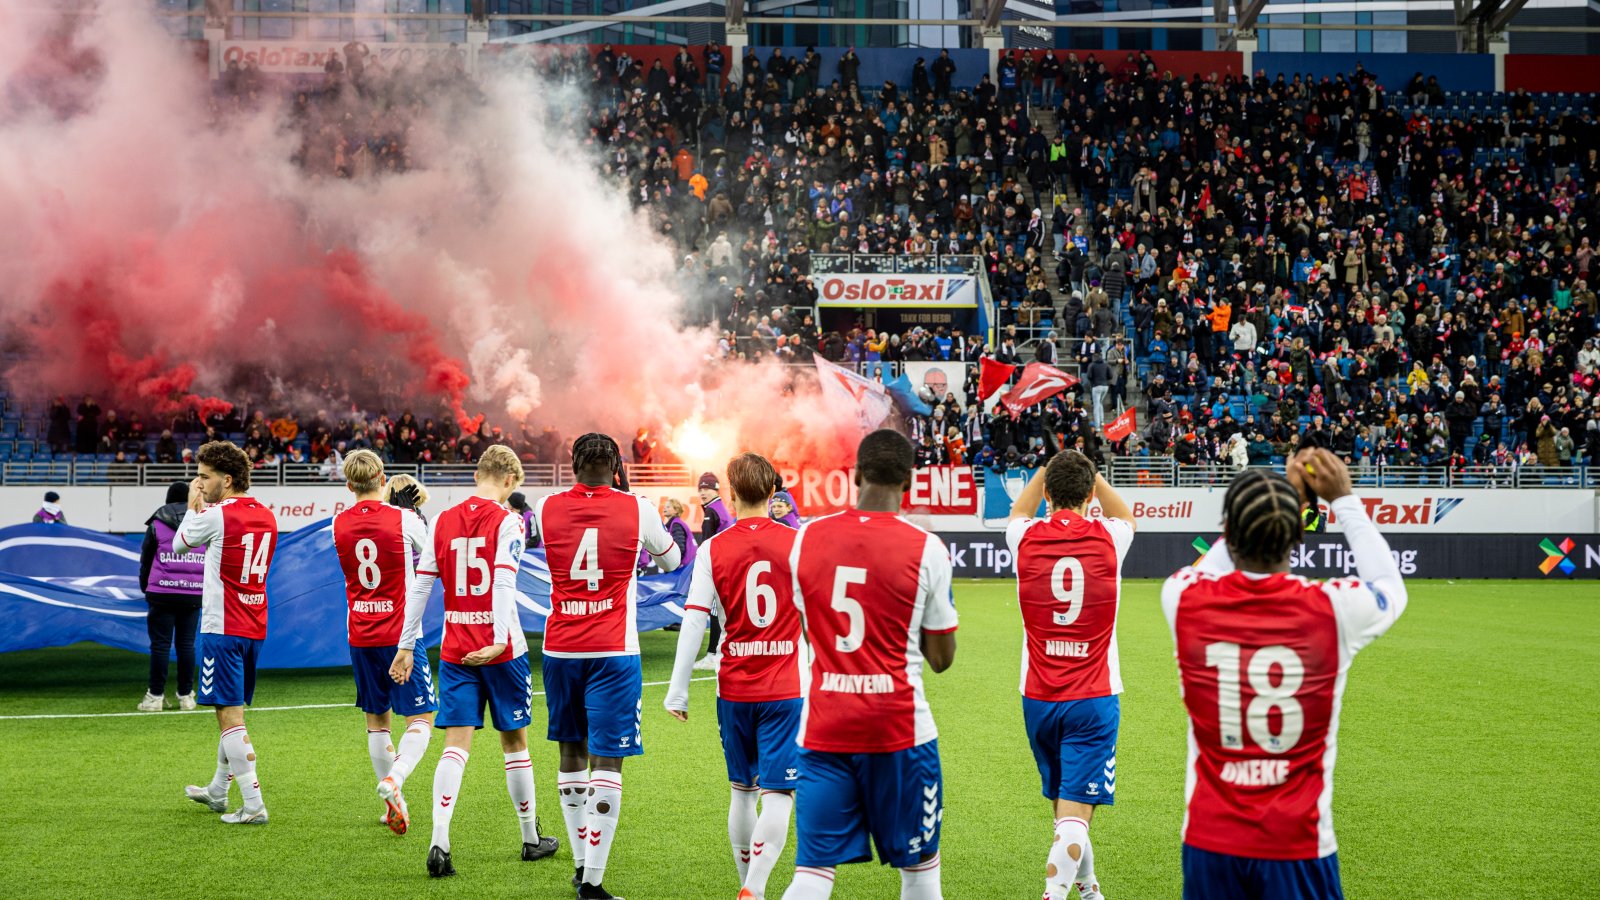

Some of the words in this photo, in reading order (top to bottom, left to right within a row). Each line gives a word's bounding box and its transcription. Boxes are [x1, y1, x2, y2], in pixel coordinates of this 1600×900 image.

[823, 278, 944, 301] OsloTaxi
[280, 503, 313, 517] ned
[1133, 501, 1192, 518] Bestill
[160, 552, 206, 564] BALLHENTE
[241, 532, 272, 584] 14
[355, 538, 381, 589] 8
[450, 537, 491, 596] 15
[570, 528, 604, 591] 4
[352, 600, 394, 613] HESTNES
[746, 561, 777, 628] 6
[831, 565, 867, 653] 5
[1051, 556, 1085, 625] 9
[728, 640, 794, 657] SVINDLAND
[1045, 640, 1089, 658] NUNEZ
[1205, 641, 1305, 754] 18
